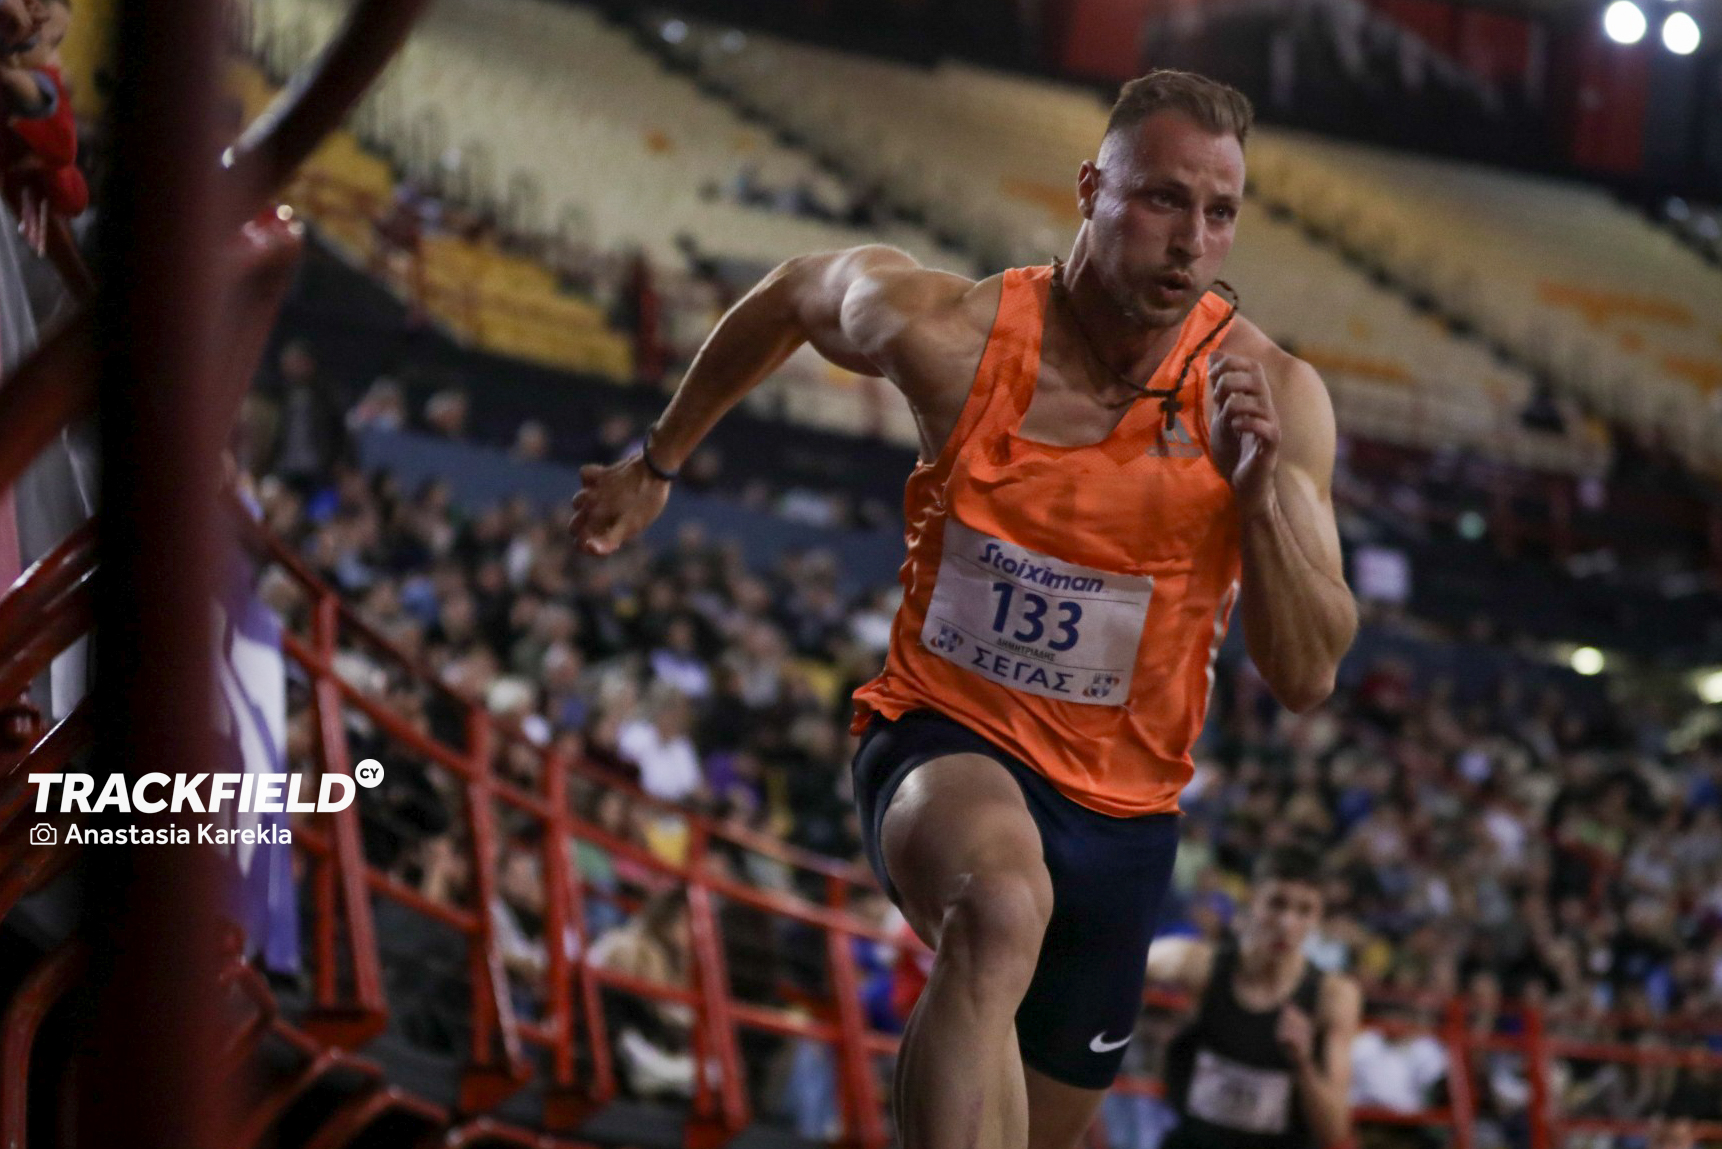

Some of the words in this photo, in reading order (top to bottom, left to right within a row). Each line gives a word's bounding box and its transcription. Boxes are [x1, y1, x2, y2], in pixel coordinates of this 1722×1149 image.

[978, 543, 1104, 593] Stoiximan
[992, 581, 1083, 652] 133
[971, 646, 1074, 693] ΣΕΓΑΣ
